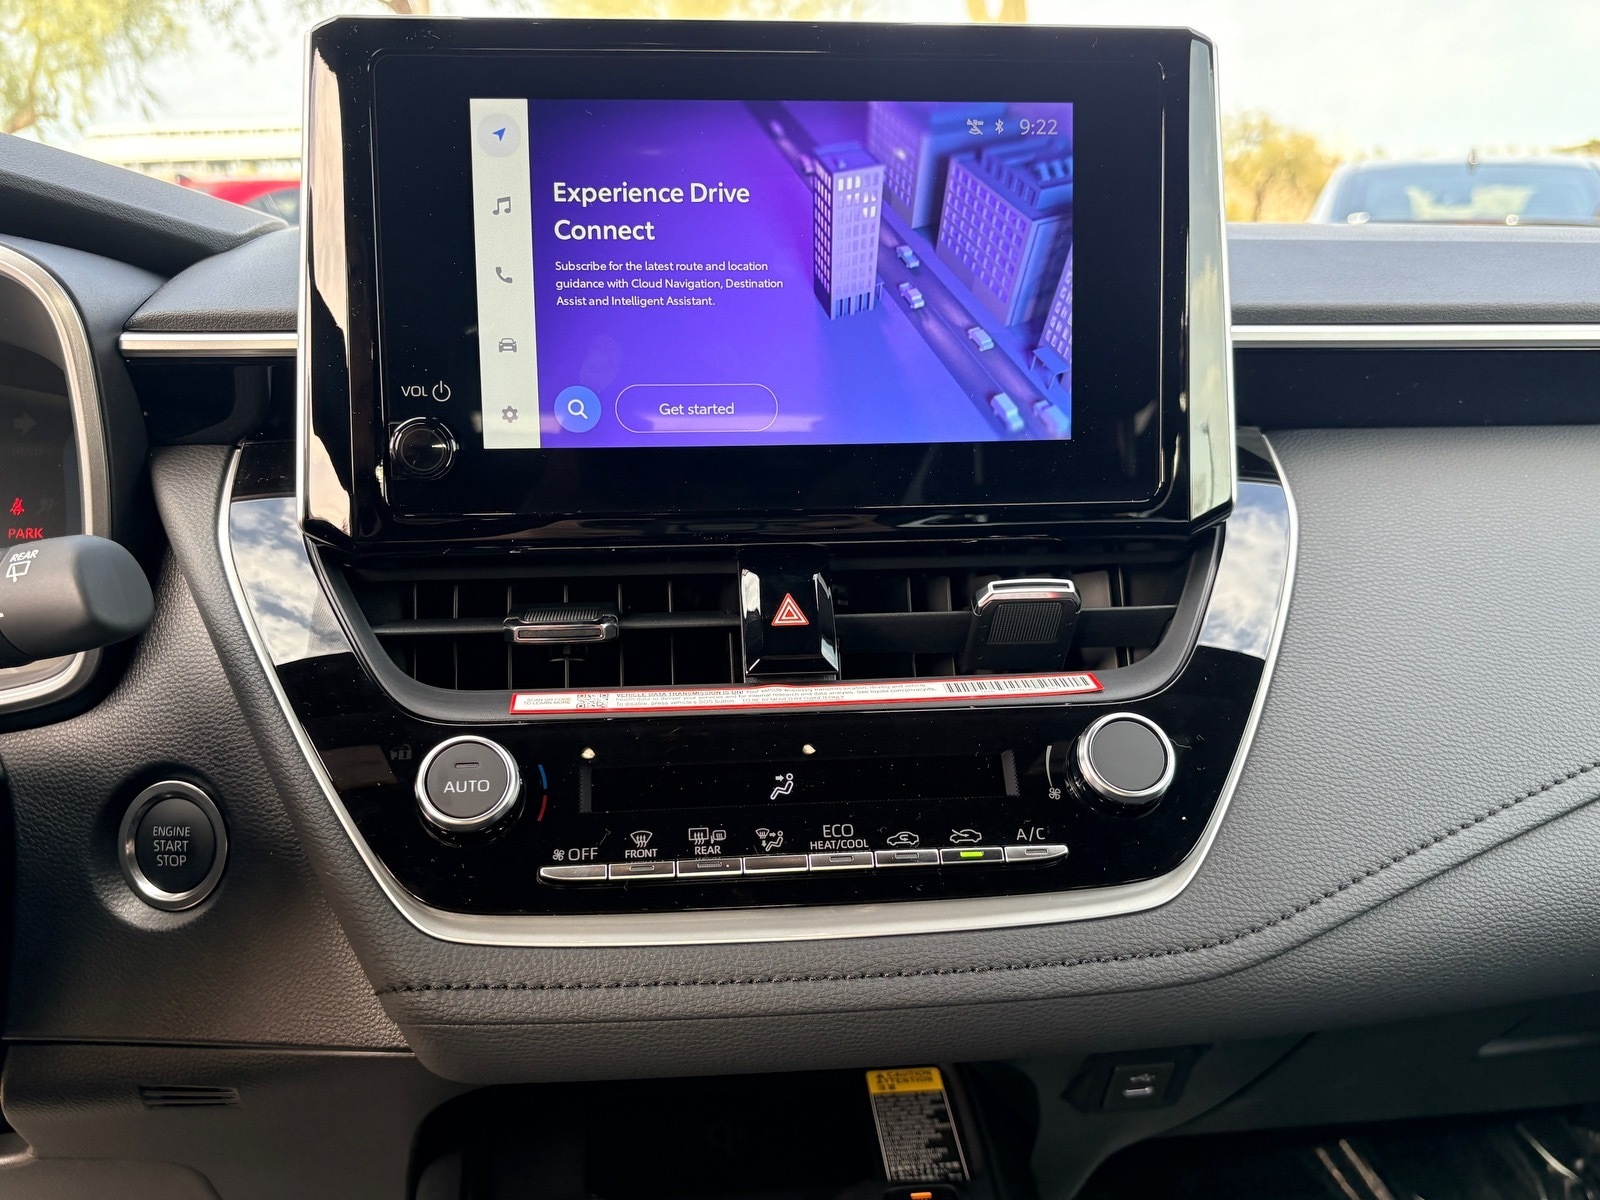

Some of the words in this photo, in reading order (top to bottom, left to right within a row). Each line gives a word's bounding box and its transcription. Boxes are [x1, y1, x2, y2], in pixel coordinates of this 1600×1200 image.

[1019, 119, 1058, 135] 9:22
[553, 182, 684, 208] Experience
[690, 182, 750, 203] Drive
[554, 219, 656, 241] Connect
[555, 261, 607, 271] Subscribe
[609, 261, 624, 271] for
[625, 261, 643, 271] the
[644, 261, 674, 271] latest
[675, 262, 704, 271] route
[705, 261, 726, 271] and
[727, 261, 768, 271] location
[555, 279, 605, 292] guidance
[607, 279, 629, 289] with
[631, 278, 663, 289] Cloud
[664, 278, 724, 292] Navigation,
[725, 278, 784, 289] Destination
[556, 296, 587, 307] Assist
[588, 296, 609, 306] and
[611, 296, 664, 308] Intelligent
[666, 295, 716, 306] Assistant.
[400, 385, 429, 397] VOL
[659, 403, 685, 415] Get
[687, 402, 735, 415] started
[8, 527, 44, 539] PARK
[9, 549, 39, 563] REAR
[443, 779, 490, 793] AUTO
[153, 826, 191, 837] ENGINE
[822, 823, 854, 838] ECO
[1016, 826, 1046, 841] A/C
[153, 839, 189, 852] START
[694, 845, 721, 855] REAR
[810, 838, 869, 850] HEAT/COOL
[567, 847, 599, 861] OFF
[625, 848, 658, 859] FRONT
[156, 854, 187, 867] STOP
